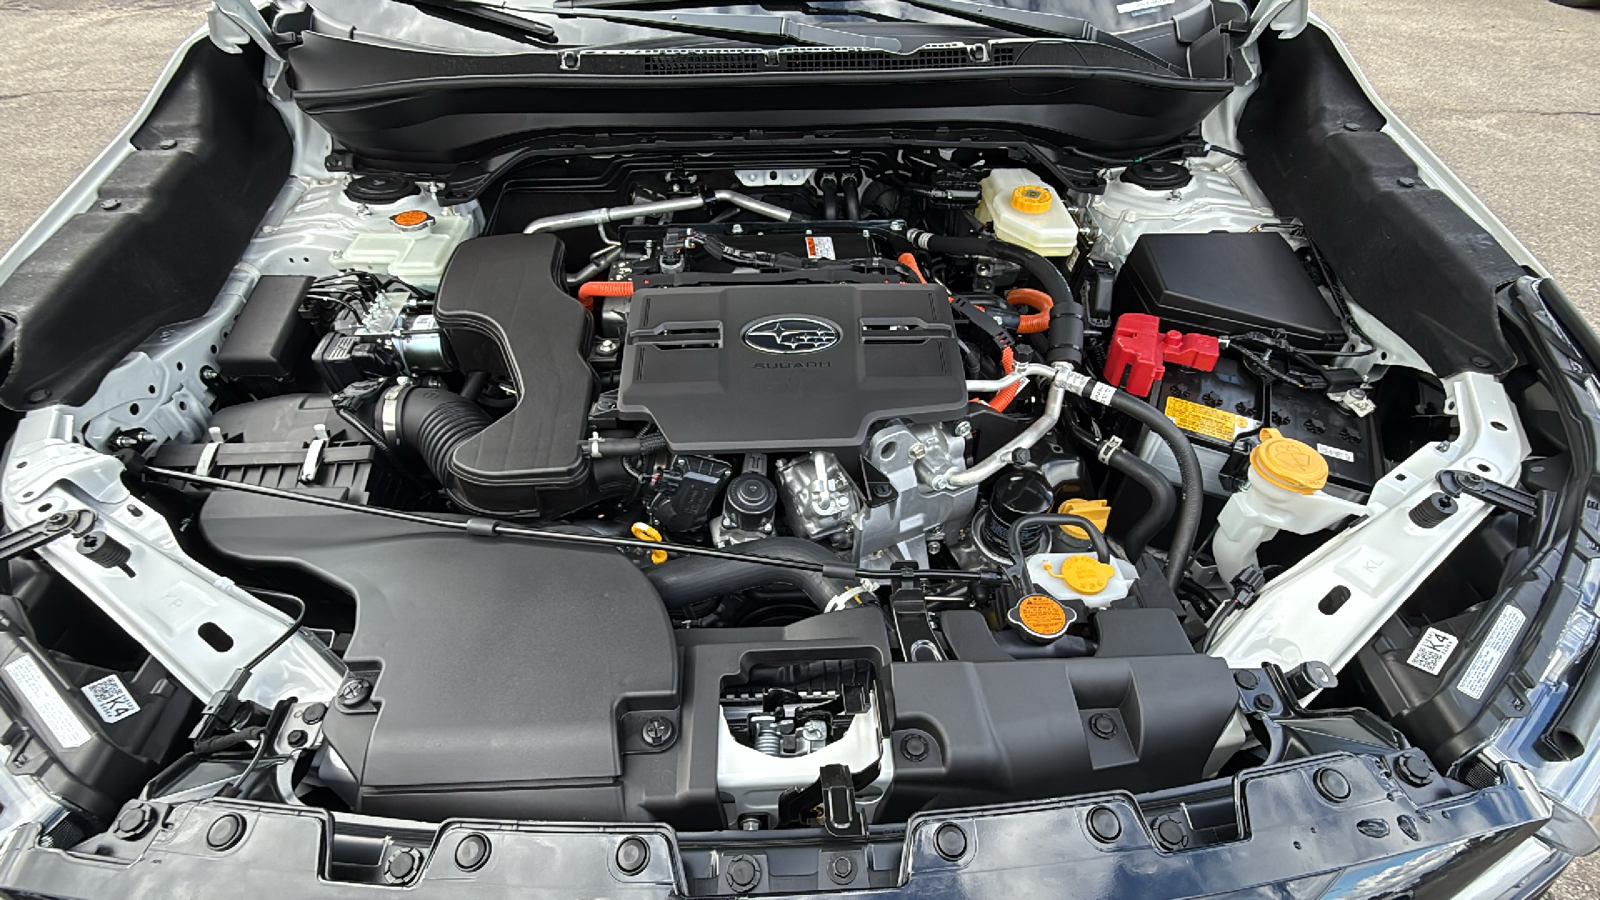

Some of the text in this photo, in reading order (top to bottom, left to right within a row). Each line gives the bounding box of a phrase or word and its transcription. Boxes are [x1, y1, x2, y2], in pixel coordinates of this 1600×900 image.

[753, 361, 832, 370] SUBARU
[1429, 633, 1449, 653] K4
[107, 695, 130, 718] K4
